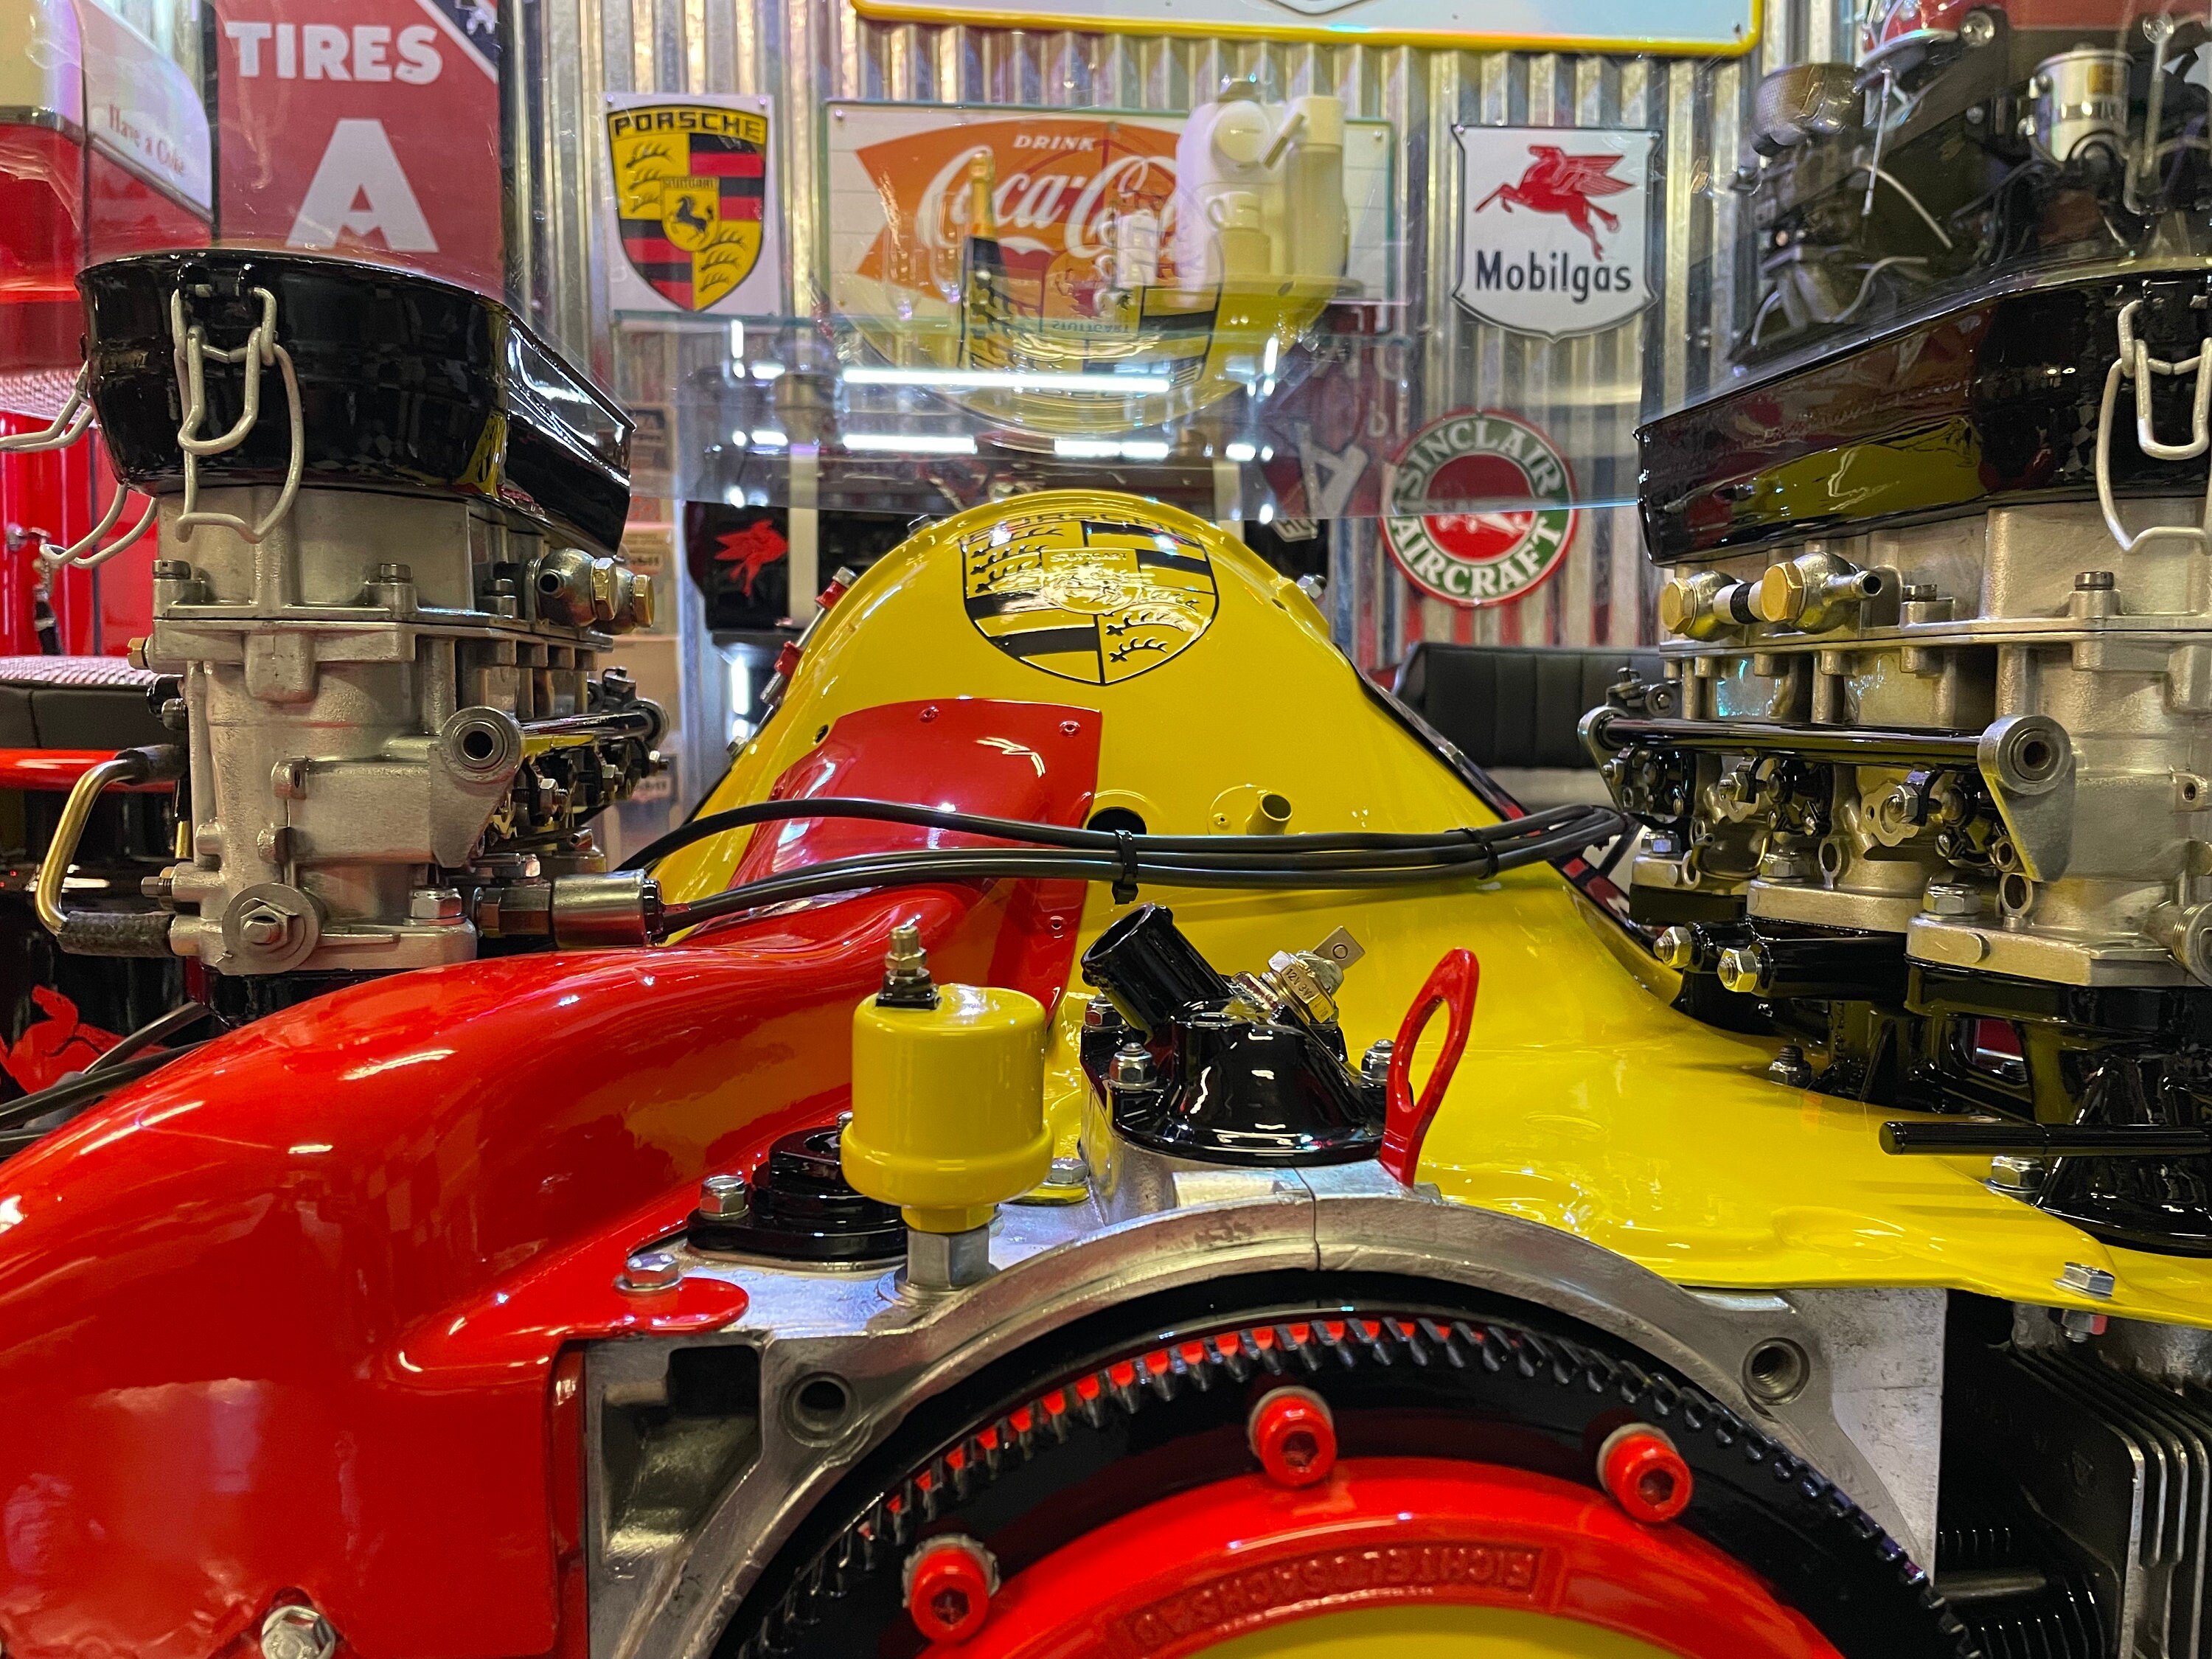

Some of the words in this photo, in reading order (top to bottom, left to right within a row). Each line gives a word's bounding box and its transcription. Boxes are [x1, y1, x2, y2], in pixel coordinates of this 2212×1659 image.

[226, 21, 442, 85] TIRES
[108, 104, 140, 147] Have
[614, 111, 762, 140] PORSCHE
[1014, 134, 1096, 151] DRINK
[285, 118, 439, 252] A
[1476, 249, 1632, 302] Mobilgas
[1397, 420, 1562, 498] SINCLAIR
[1391, 517, 1562, 597] AIRCRAFT
[1286, 968, 1300, 985] 12V
